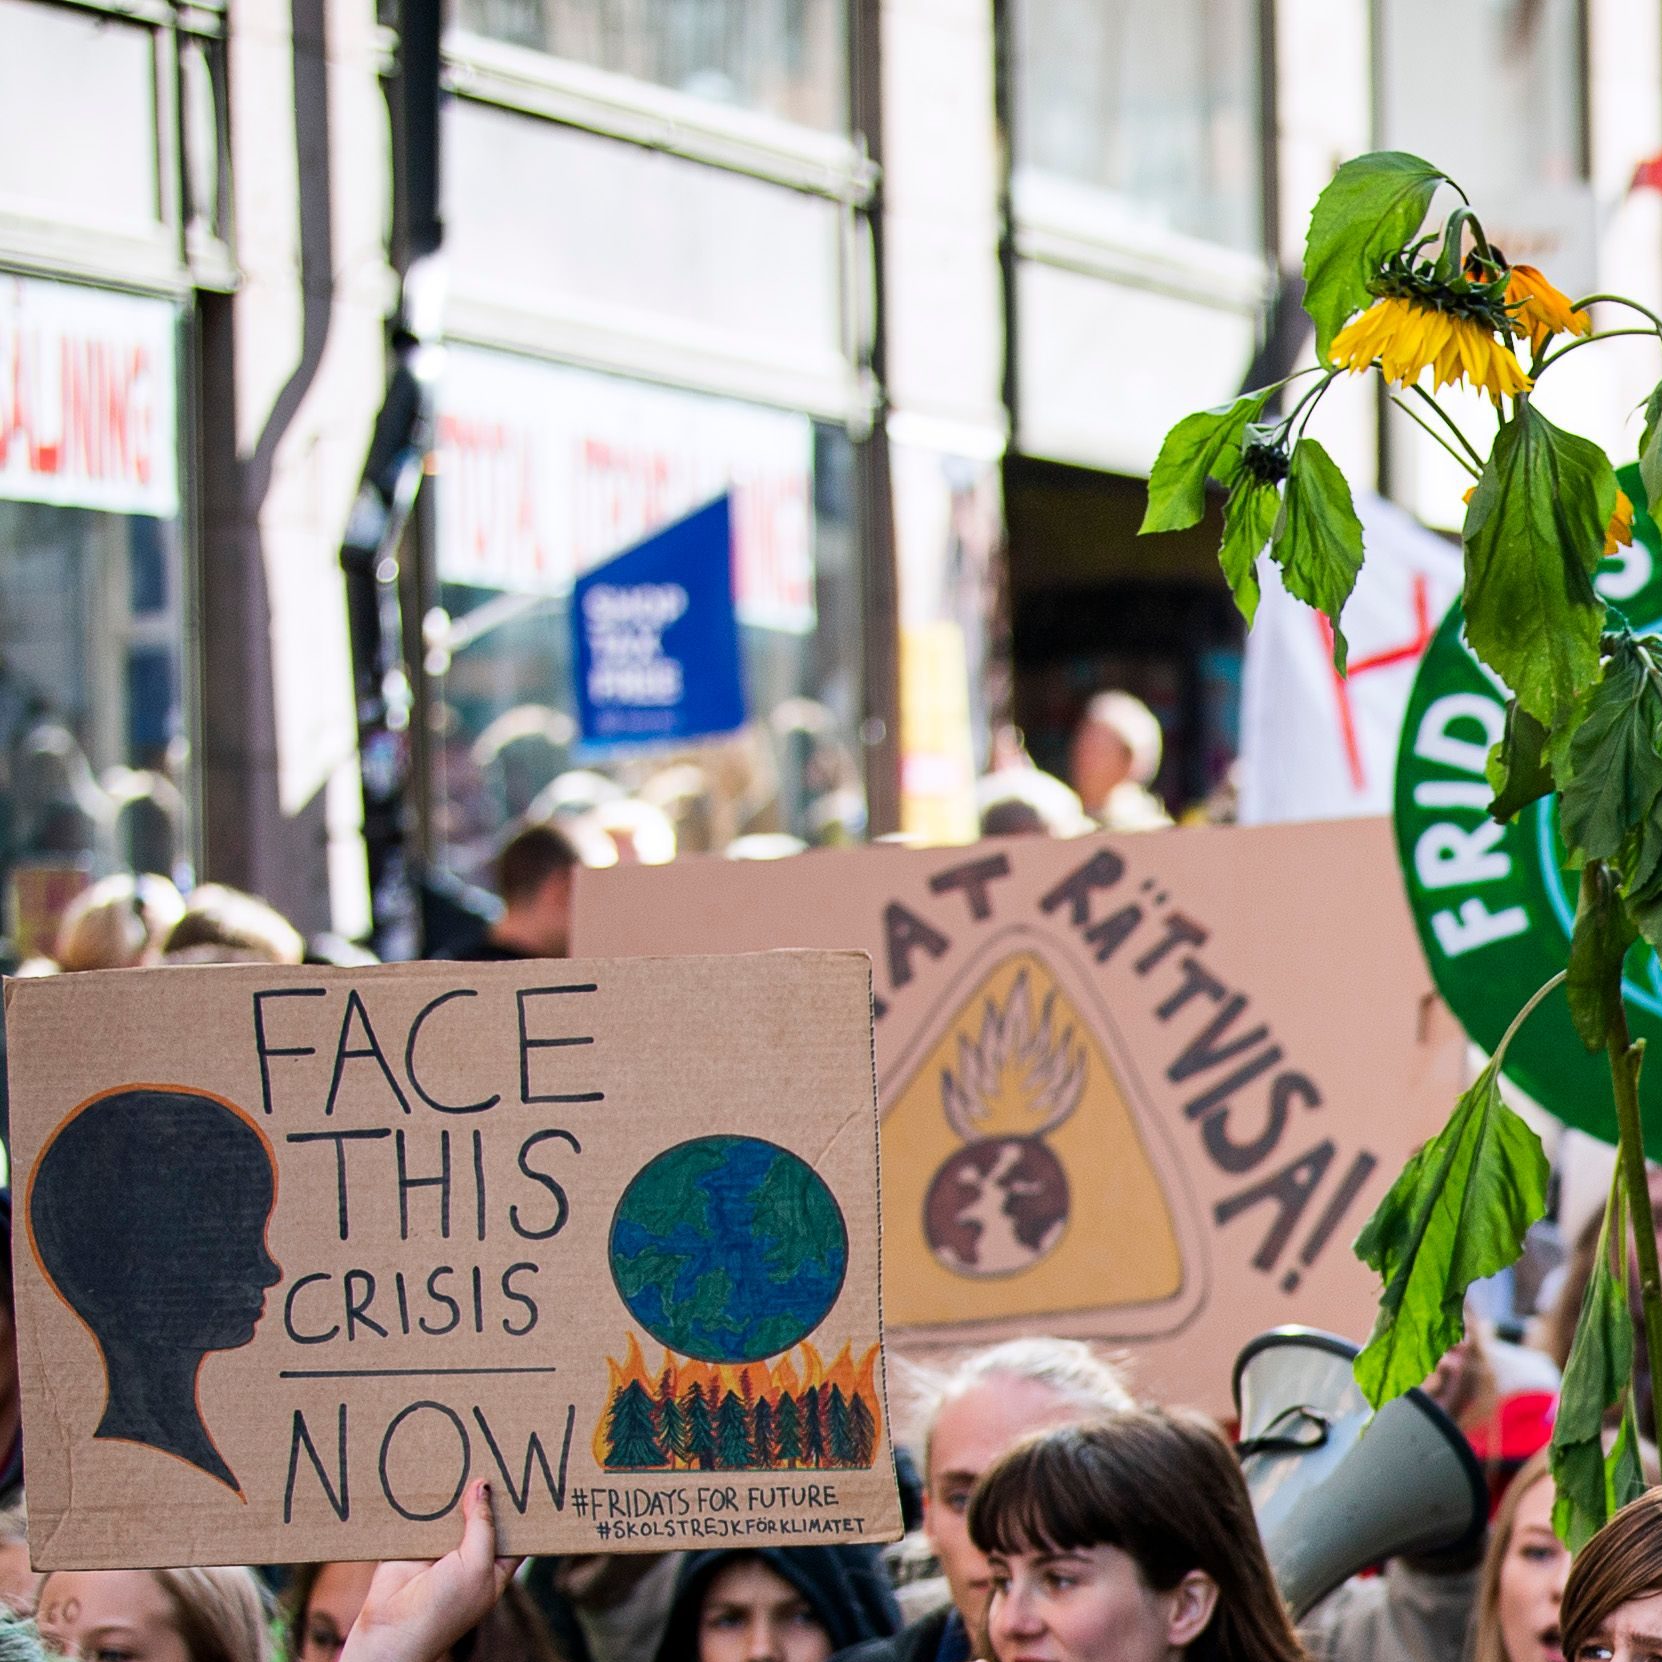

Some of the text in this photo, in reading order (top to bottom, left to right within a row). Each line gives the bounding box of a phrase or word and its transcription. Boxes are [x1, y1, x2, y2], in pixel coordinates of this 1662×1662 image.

[251, 983, 605, 1116] FACE
[1039, 846, 1378, 1296] RÄTTVISA!
[286, 1127, 583, 1241] THIS
[283, 1262, 540, 1344] CRISIS
[282, 1402, 577, 1524] NOW
[570, 1484, 840, 1522] #FRIDAYS FOR FUTURE
